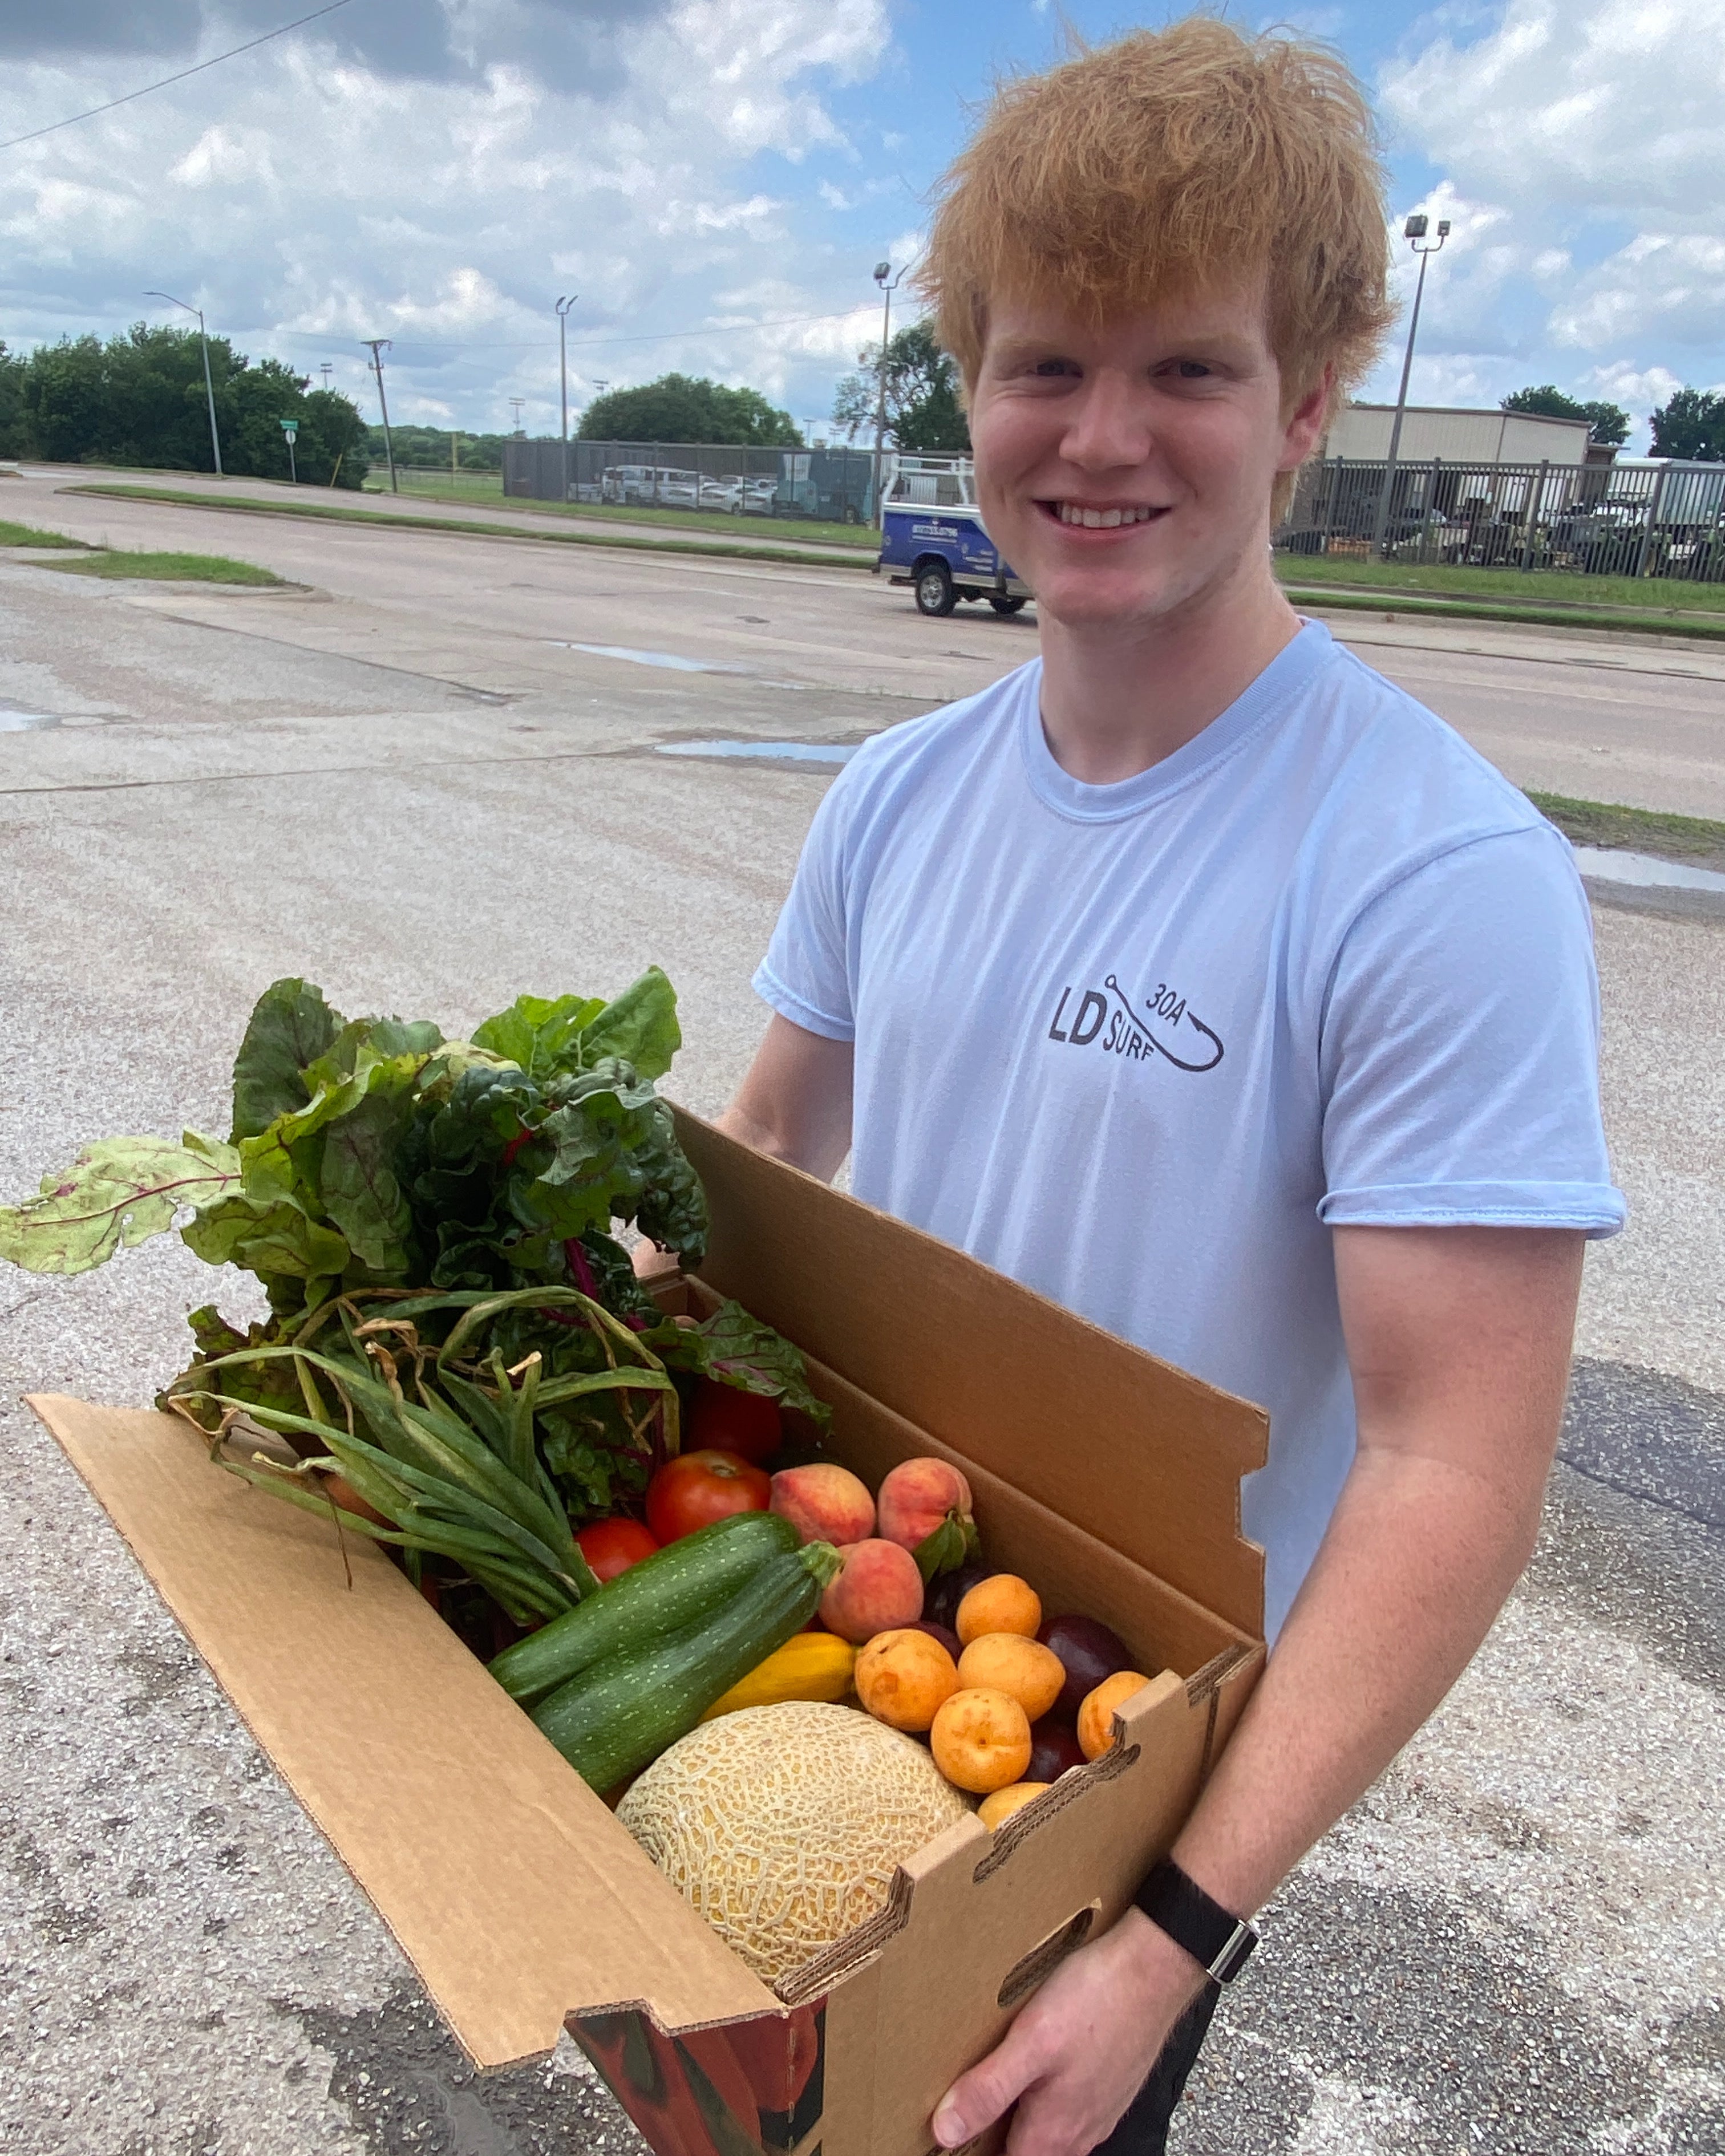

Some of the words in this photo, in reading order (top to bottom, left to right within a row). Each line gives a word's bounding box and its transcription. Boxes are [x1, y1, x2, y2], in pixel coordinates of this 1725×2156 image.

[1049, 987, 1107, 1045] LD
[1103, 1010, 1154, 1060] SURF
[1145, 983, 1187, 1026] 30A
